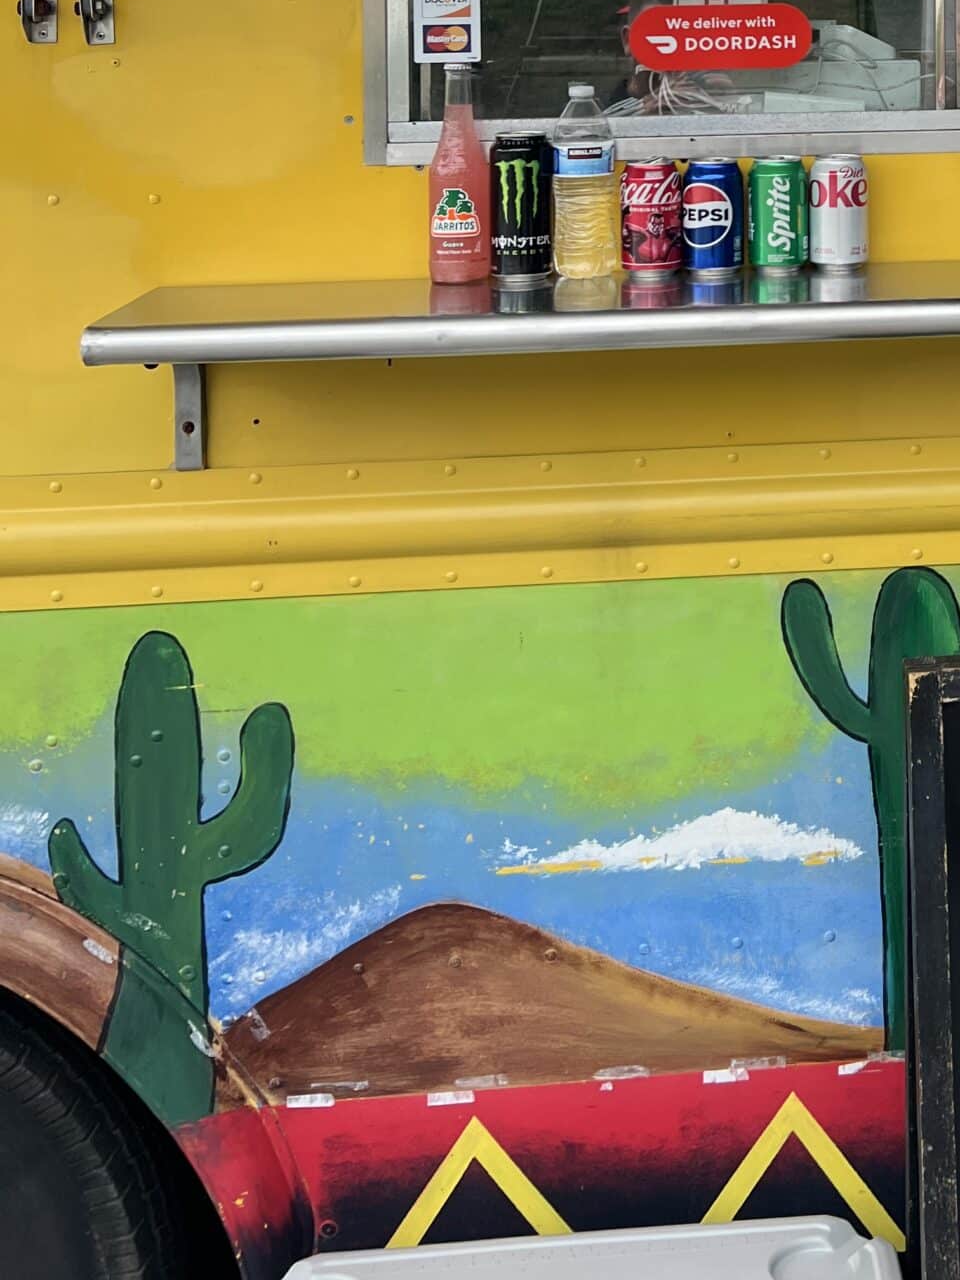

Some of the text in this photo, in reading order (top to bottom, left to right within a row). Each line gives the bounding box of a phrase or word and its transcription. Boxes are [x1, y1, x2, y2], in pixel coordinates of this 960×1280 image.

[665, 16, 776, 30] We deliver with
[684, 35, 797, 52] DOORDASH
[682, 209, 730, 222] PEPSI
[767, 176, 796, 252] Sprite
[434, 221, 475, 232] JARRITOS
